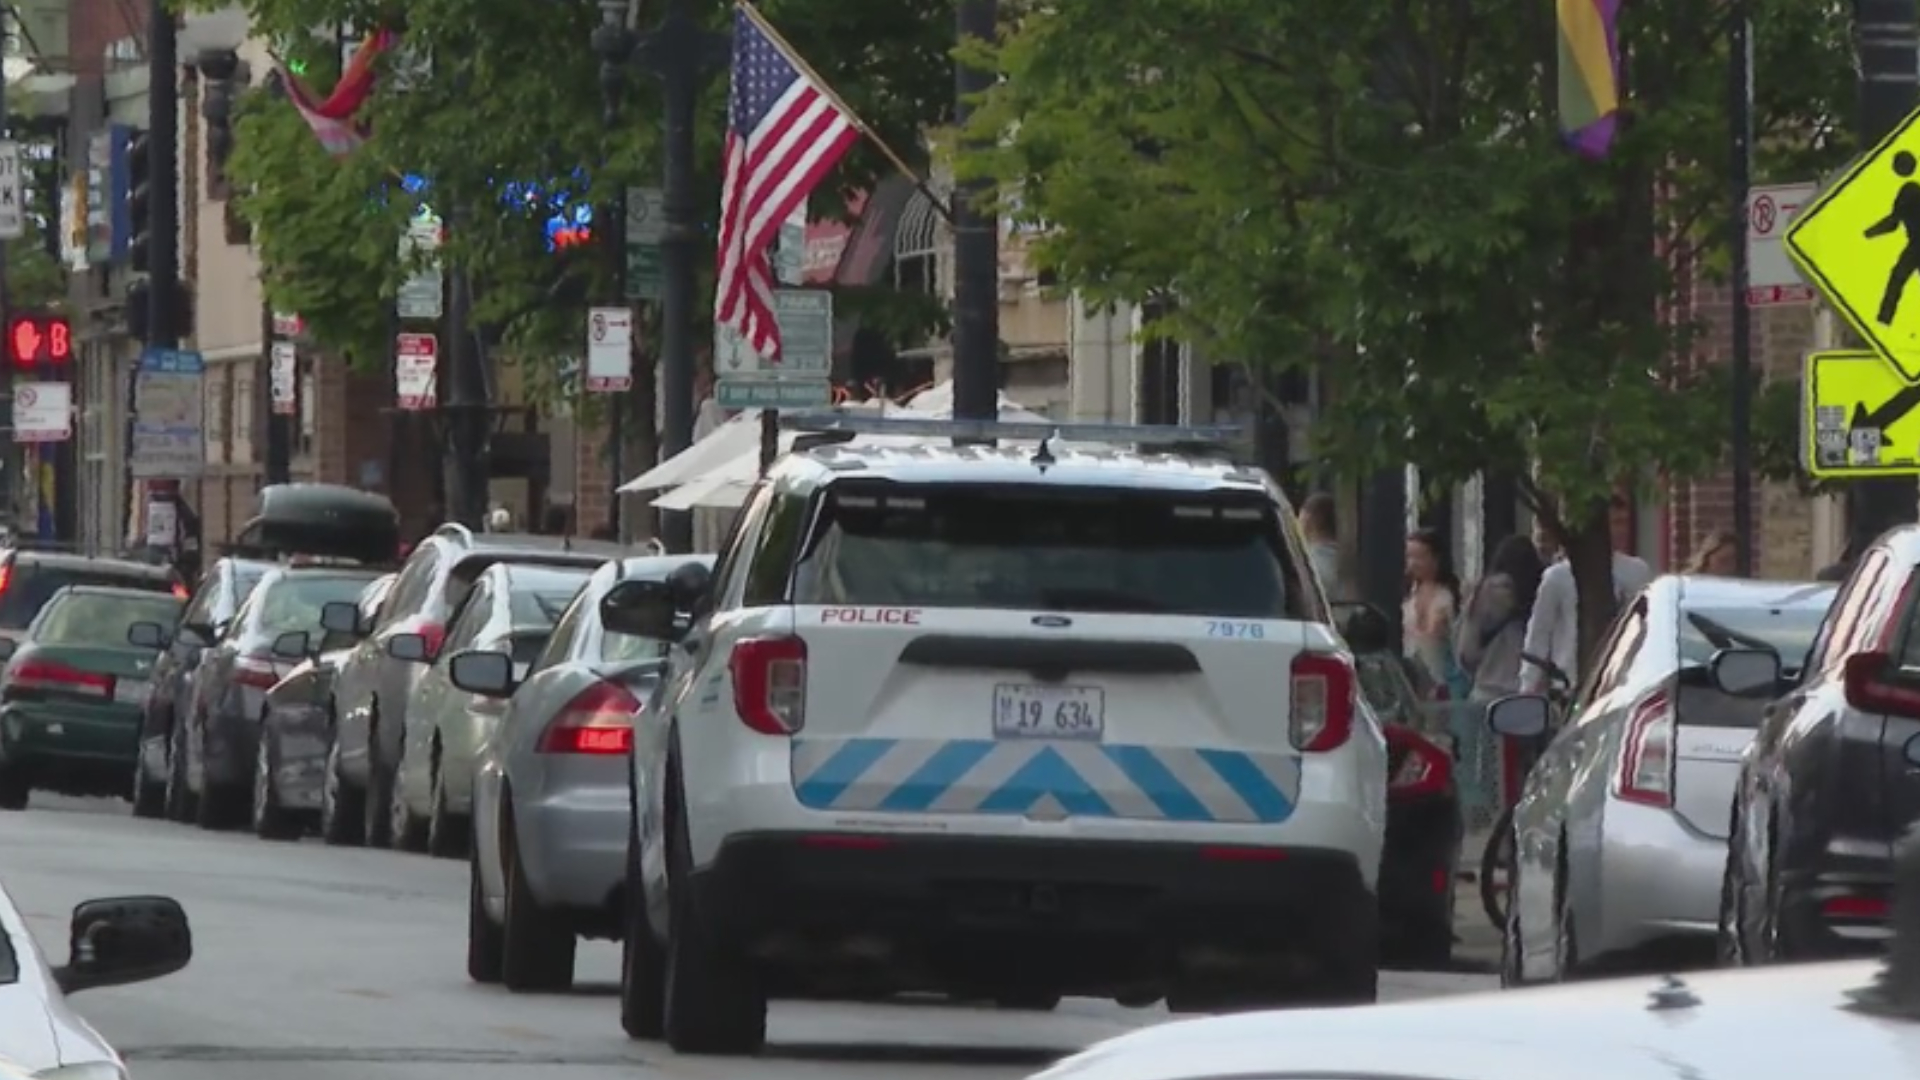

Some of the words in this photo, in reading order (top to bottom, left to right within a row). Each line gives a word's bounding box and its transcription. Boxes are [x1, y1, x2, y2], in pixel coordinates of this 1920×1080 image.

[821, 608, 922, 625] POLICE
[1018, 699, 1043, 728] 19
[1054, 700, 1094, 729] 634
